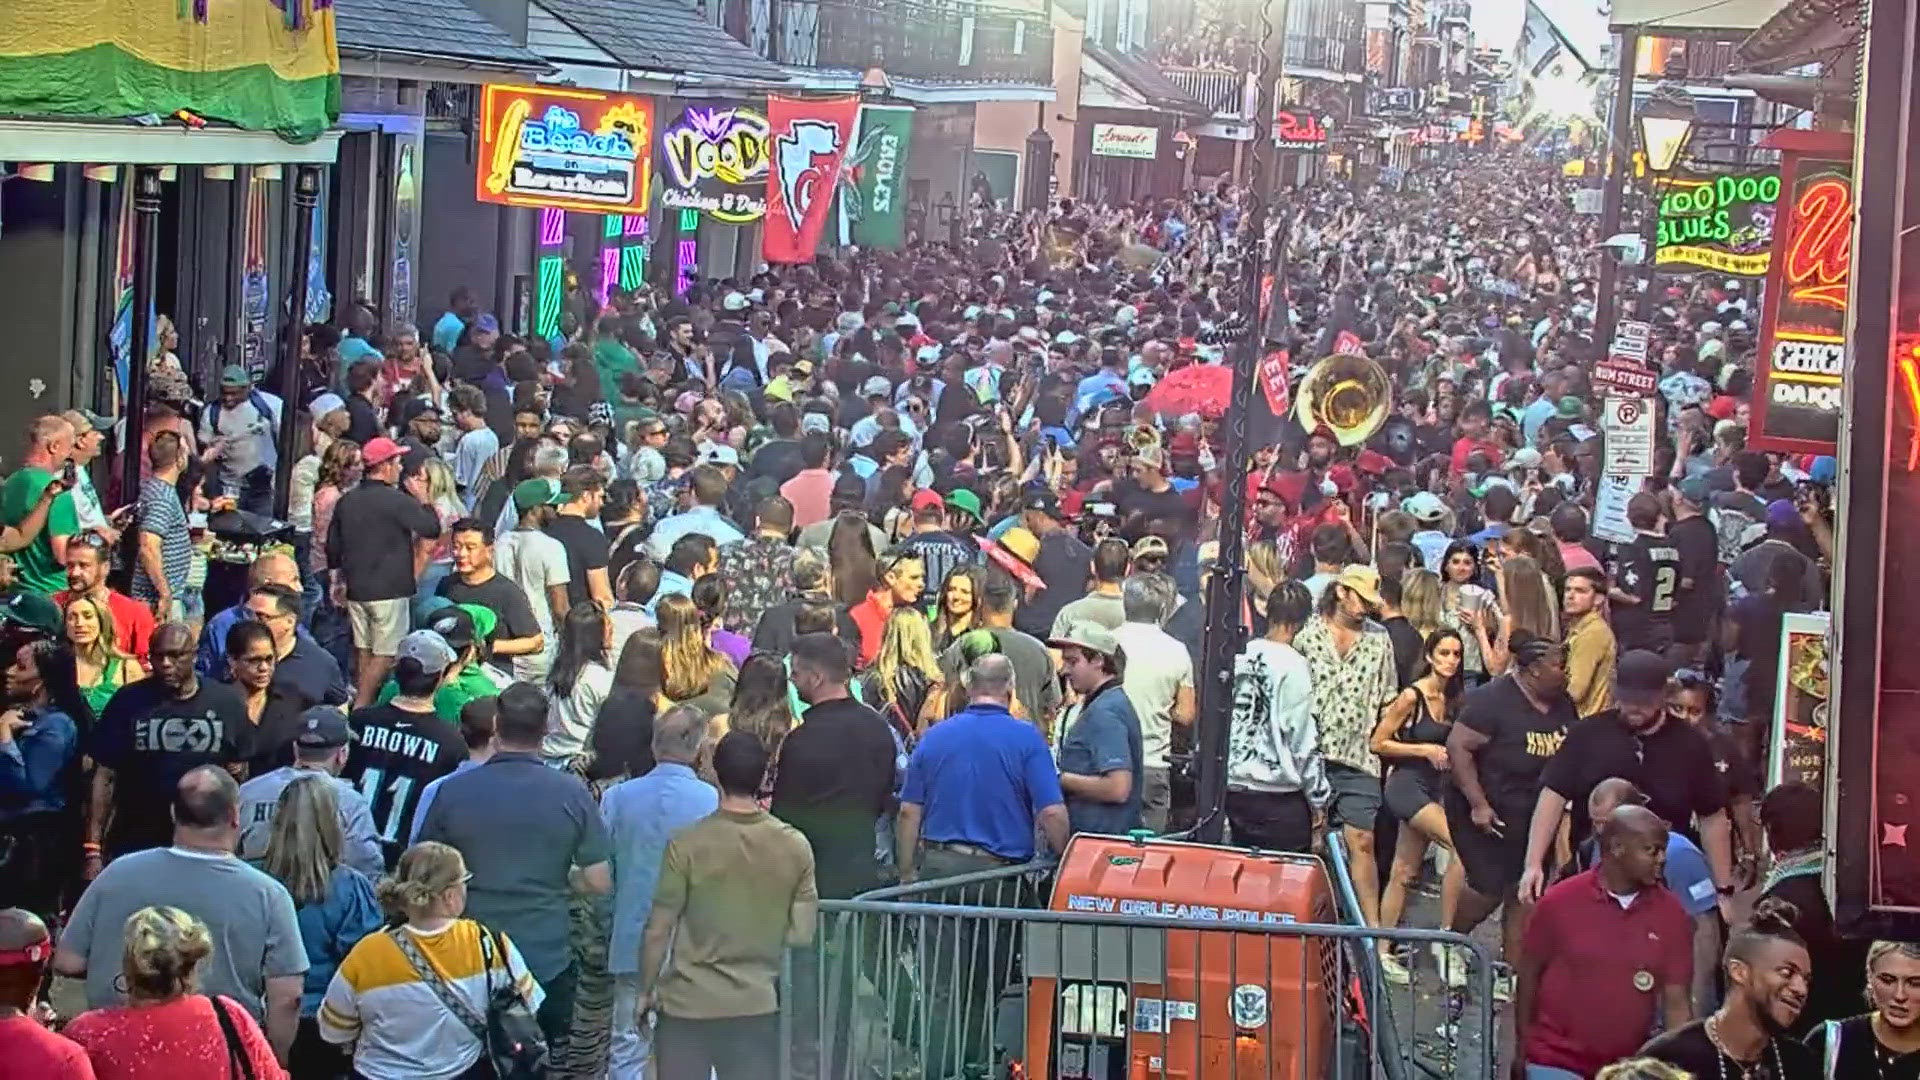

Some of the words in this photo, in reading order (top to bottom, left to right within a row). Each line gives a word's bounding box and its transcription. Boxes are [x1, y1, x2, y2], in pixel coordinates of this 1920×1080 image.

[521, 121, 637, 160] Beach
[664, 129, 770, 188] VOOD
[1656, 210, 1730, 247] BLUES
[1774, 341, 1844, 375] CHIC
[1616, 370, 1655, 390] STREET
[1652, 566, 1677, 612] 2
[360, 725, 440, 765] BROWN
[358, 765, 415, 843] 11
[1068, 894, 1117, 912] NEW
[1119, 899, 1219, 922] ORLEANS
[1221, 908, 1297, 925] POLICE
